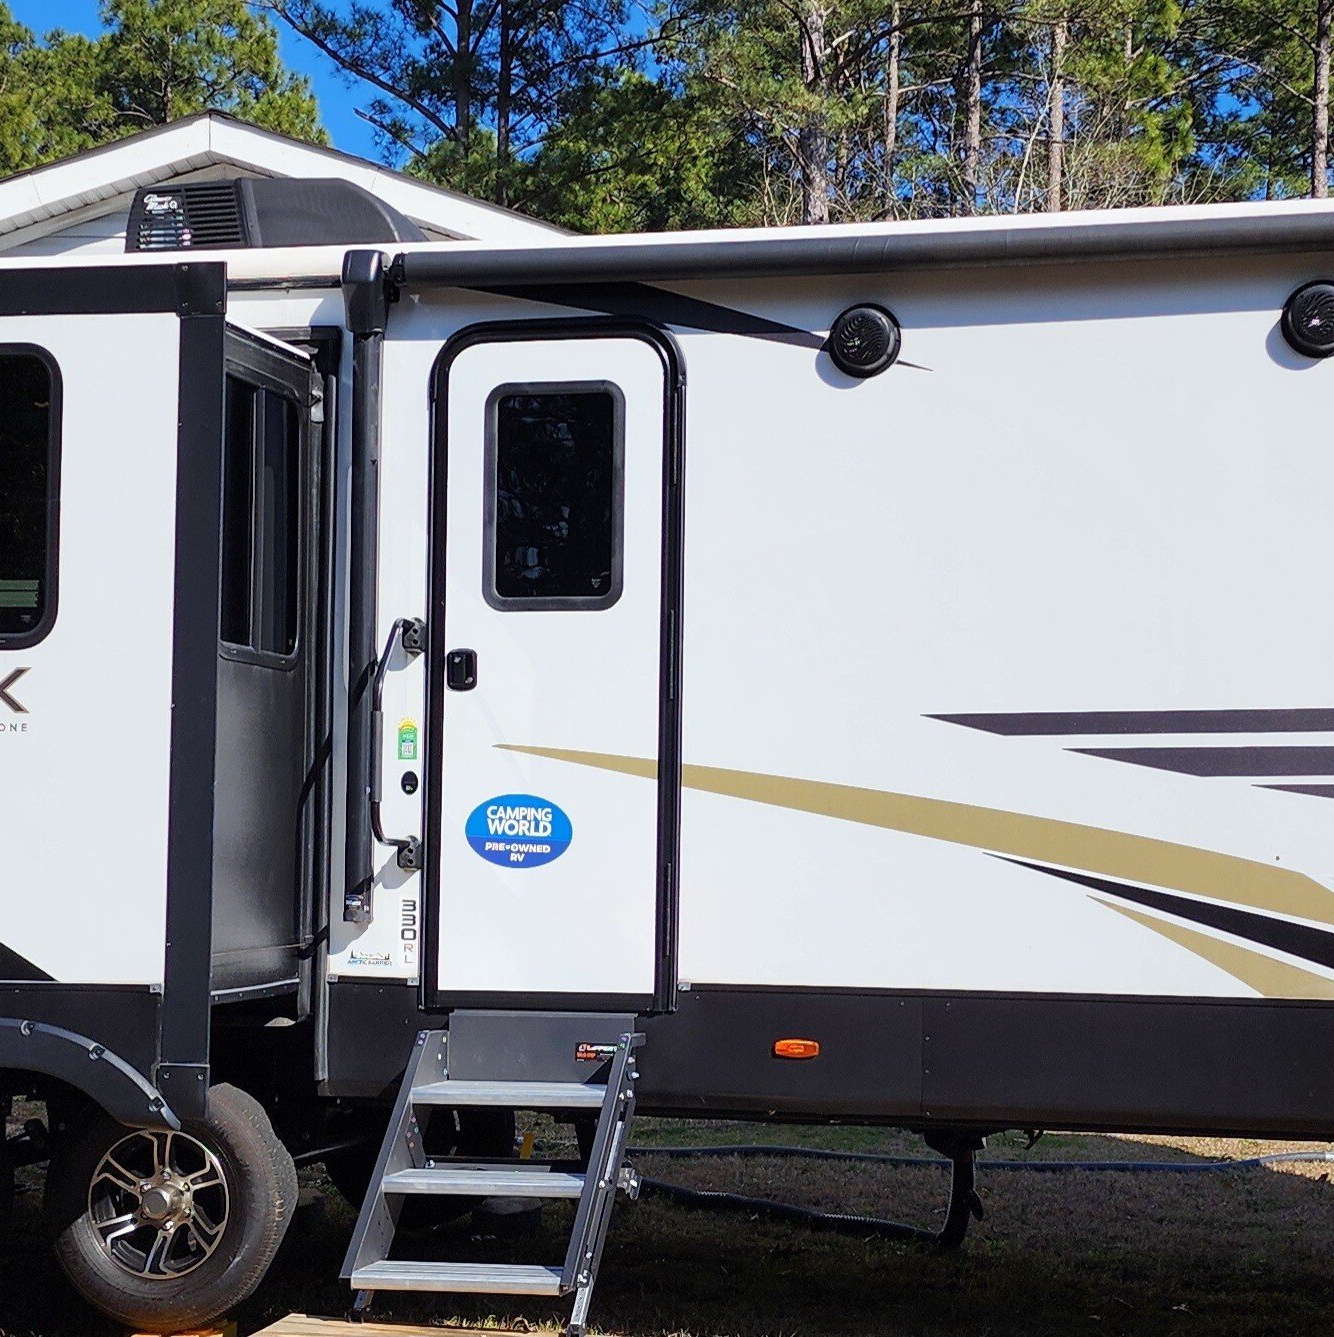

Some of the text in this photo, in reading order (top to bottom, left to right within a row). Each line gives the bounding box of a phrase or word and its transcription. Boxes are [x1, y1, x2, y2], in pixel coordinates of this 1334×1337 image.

[486, 805, 553, 821] CAMPING
[487, 818, 552, 837] WORLD
[509, 852, 525, 862] RV
